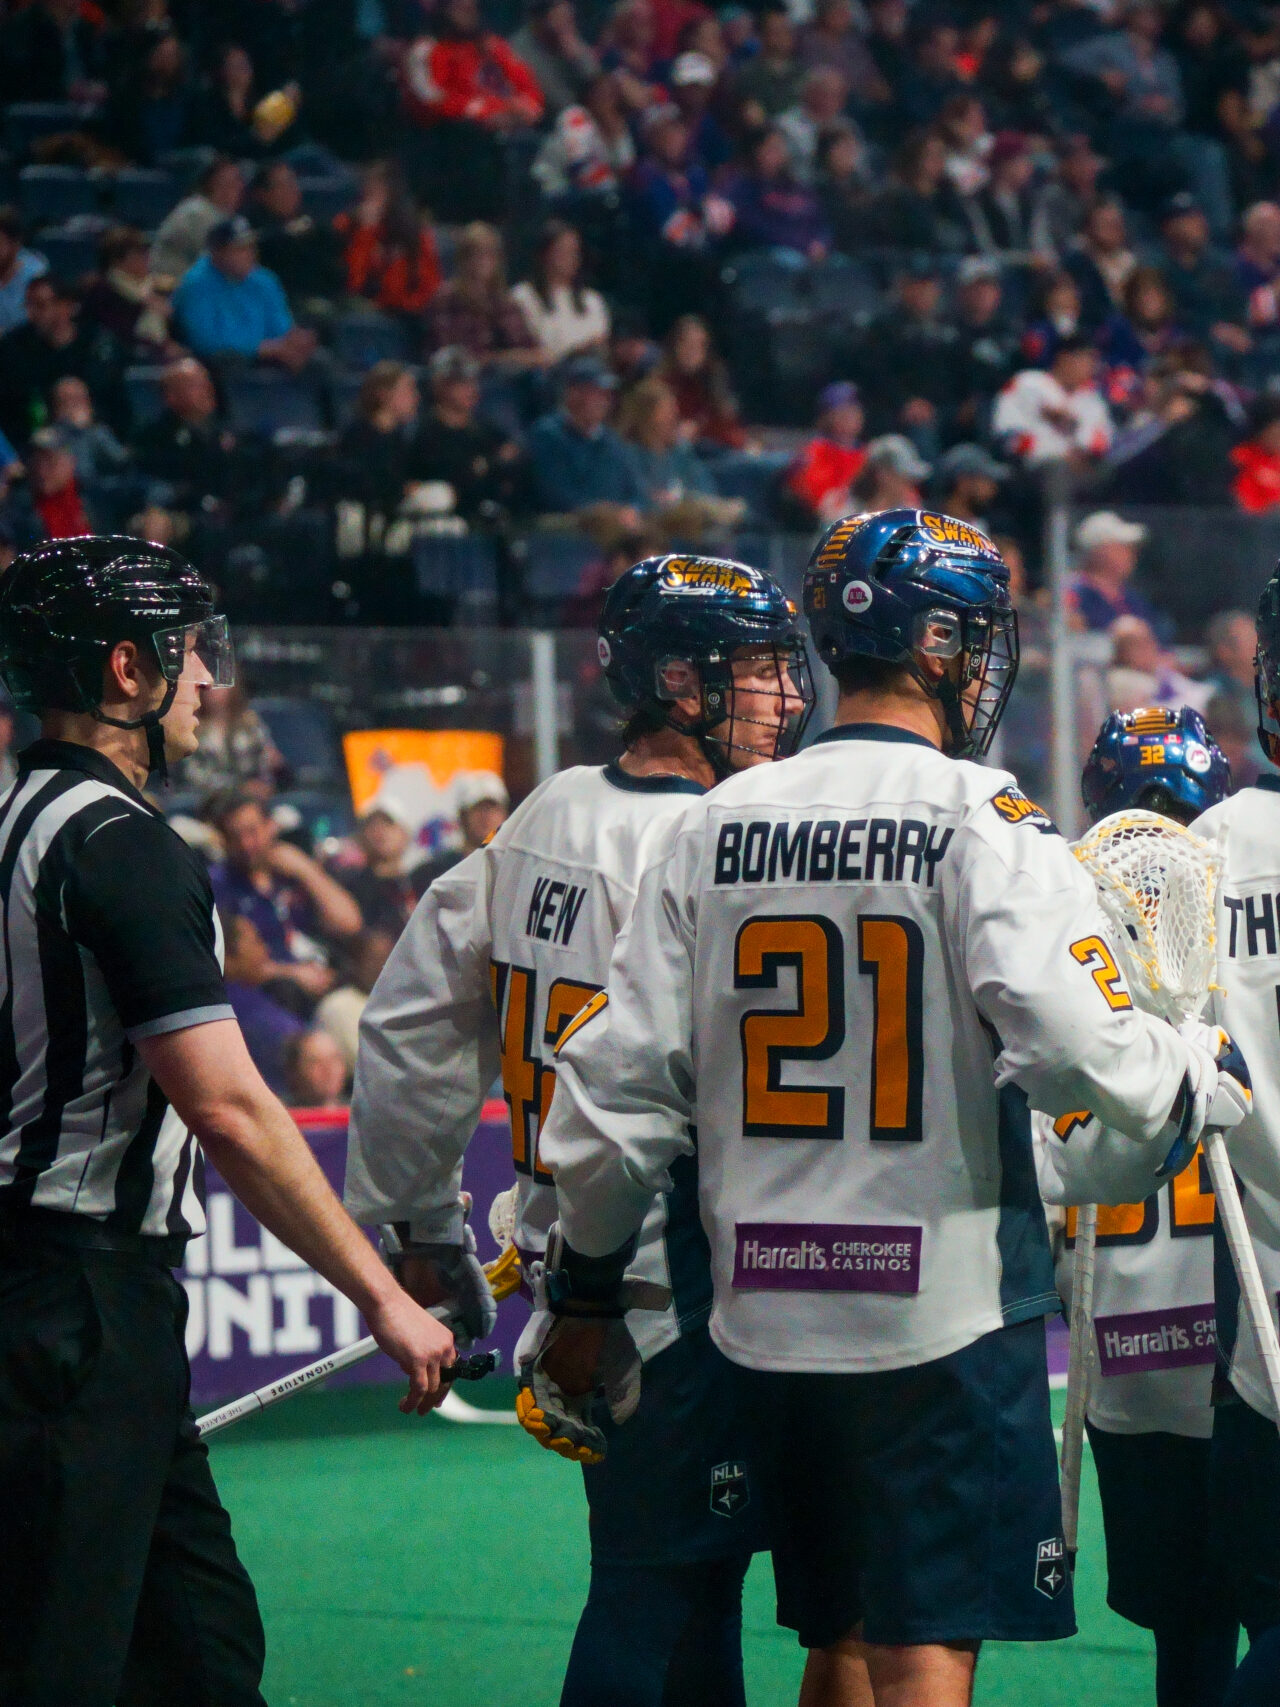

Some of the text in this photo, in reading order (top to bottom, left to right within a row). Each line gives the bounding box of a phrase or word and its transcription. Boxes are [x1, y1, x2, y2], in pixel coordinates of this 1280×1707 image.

[130, 608, 180, 616] TRUE
[1139, 745, 1166, 766] 32
[714, 818, 955, 888] BOMBERRY
[734, 914, 925, 1142] 21
[742, 1240, 826, 1270] Harrah's
[832, 1242, 912, 1258] CHEROKEE
[832, 1257, 911, 1272] CASINOS
[270, 1359, 335, 1397] SIGNATURE
[714, 1465, 744, 1481] NLL
